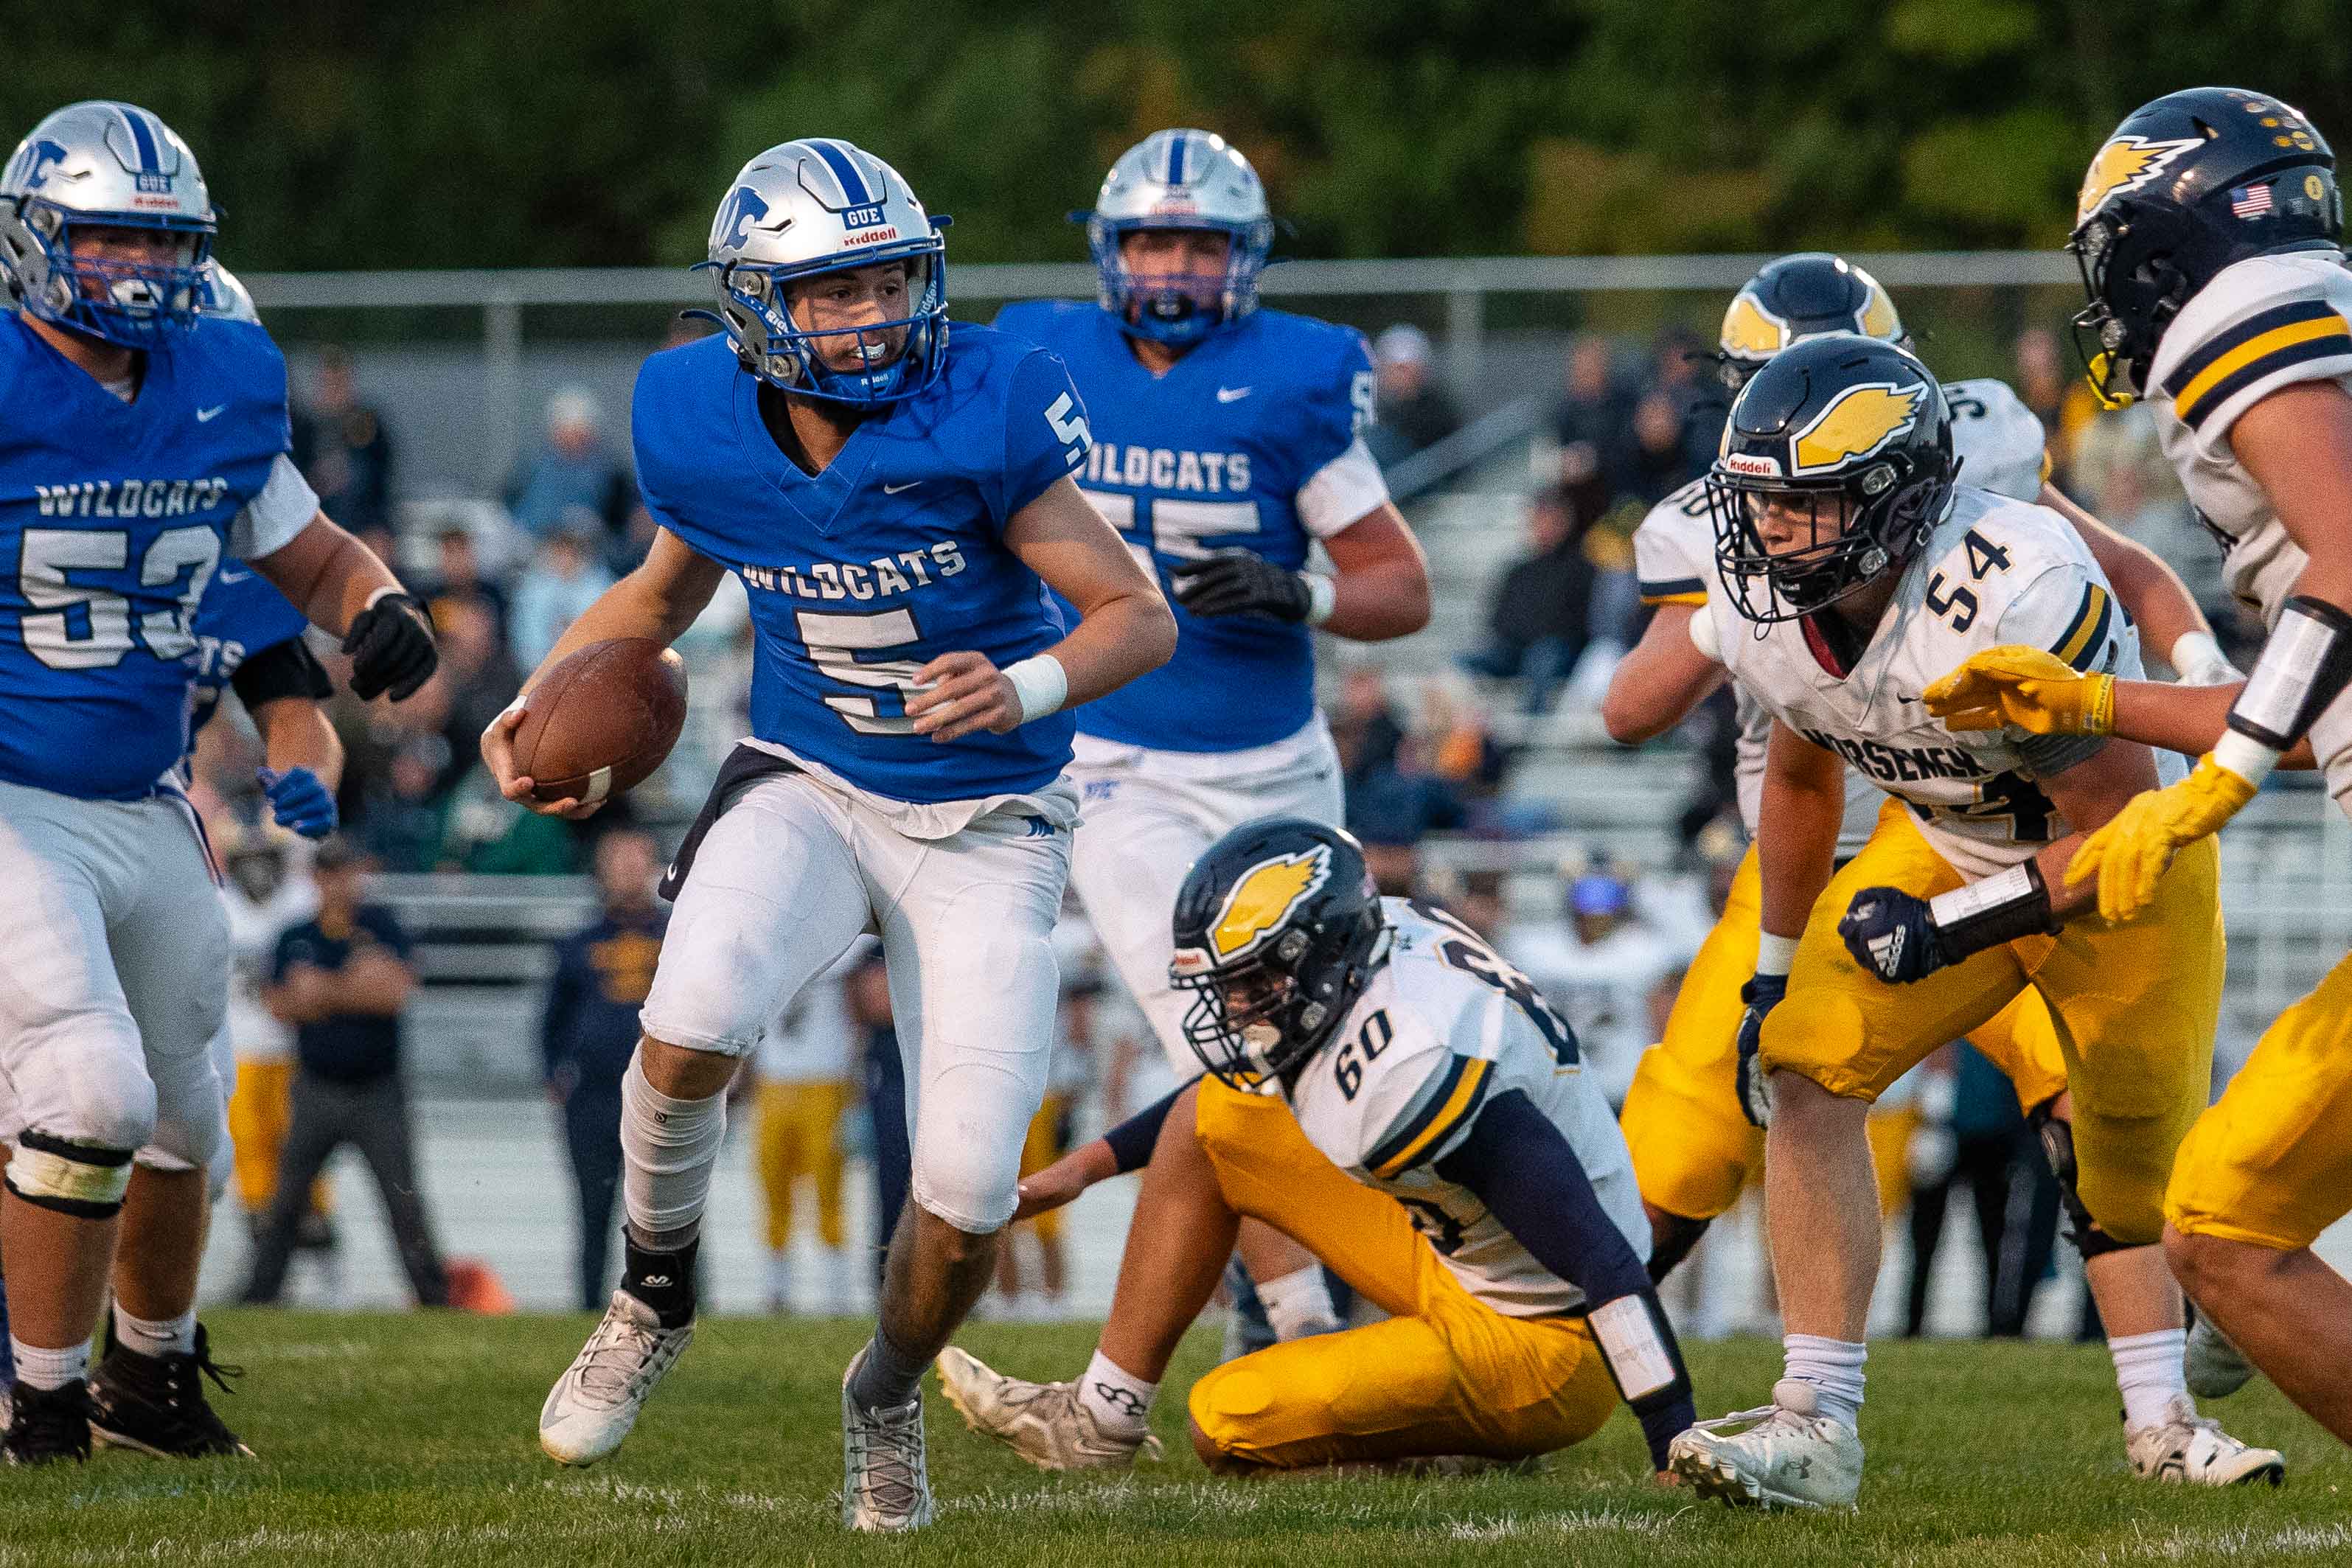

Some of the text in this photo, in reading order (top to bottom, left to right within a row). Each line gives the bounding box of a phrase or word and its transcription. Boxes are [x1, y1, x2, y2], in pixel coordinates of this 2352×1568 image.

[843, 227, 897, 246] Riddell
[847, 207, 881, 226] GUE
[1043, 391, 1093, 467] 5
[35, 475, 229, 518] WILDCATS
[1073, 442, 1252, 493] ILDCATS
[1729, 459, 1771, 474] Riddell
[21, 524, 222, 670] 53
[742, 540, 967, 600] WILDCATS
[1924, 527, 2014, 636] 54
[794, 607, 953, 736] 5
[1335, 1008, 1394, 1101] 60
